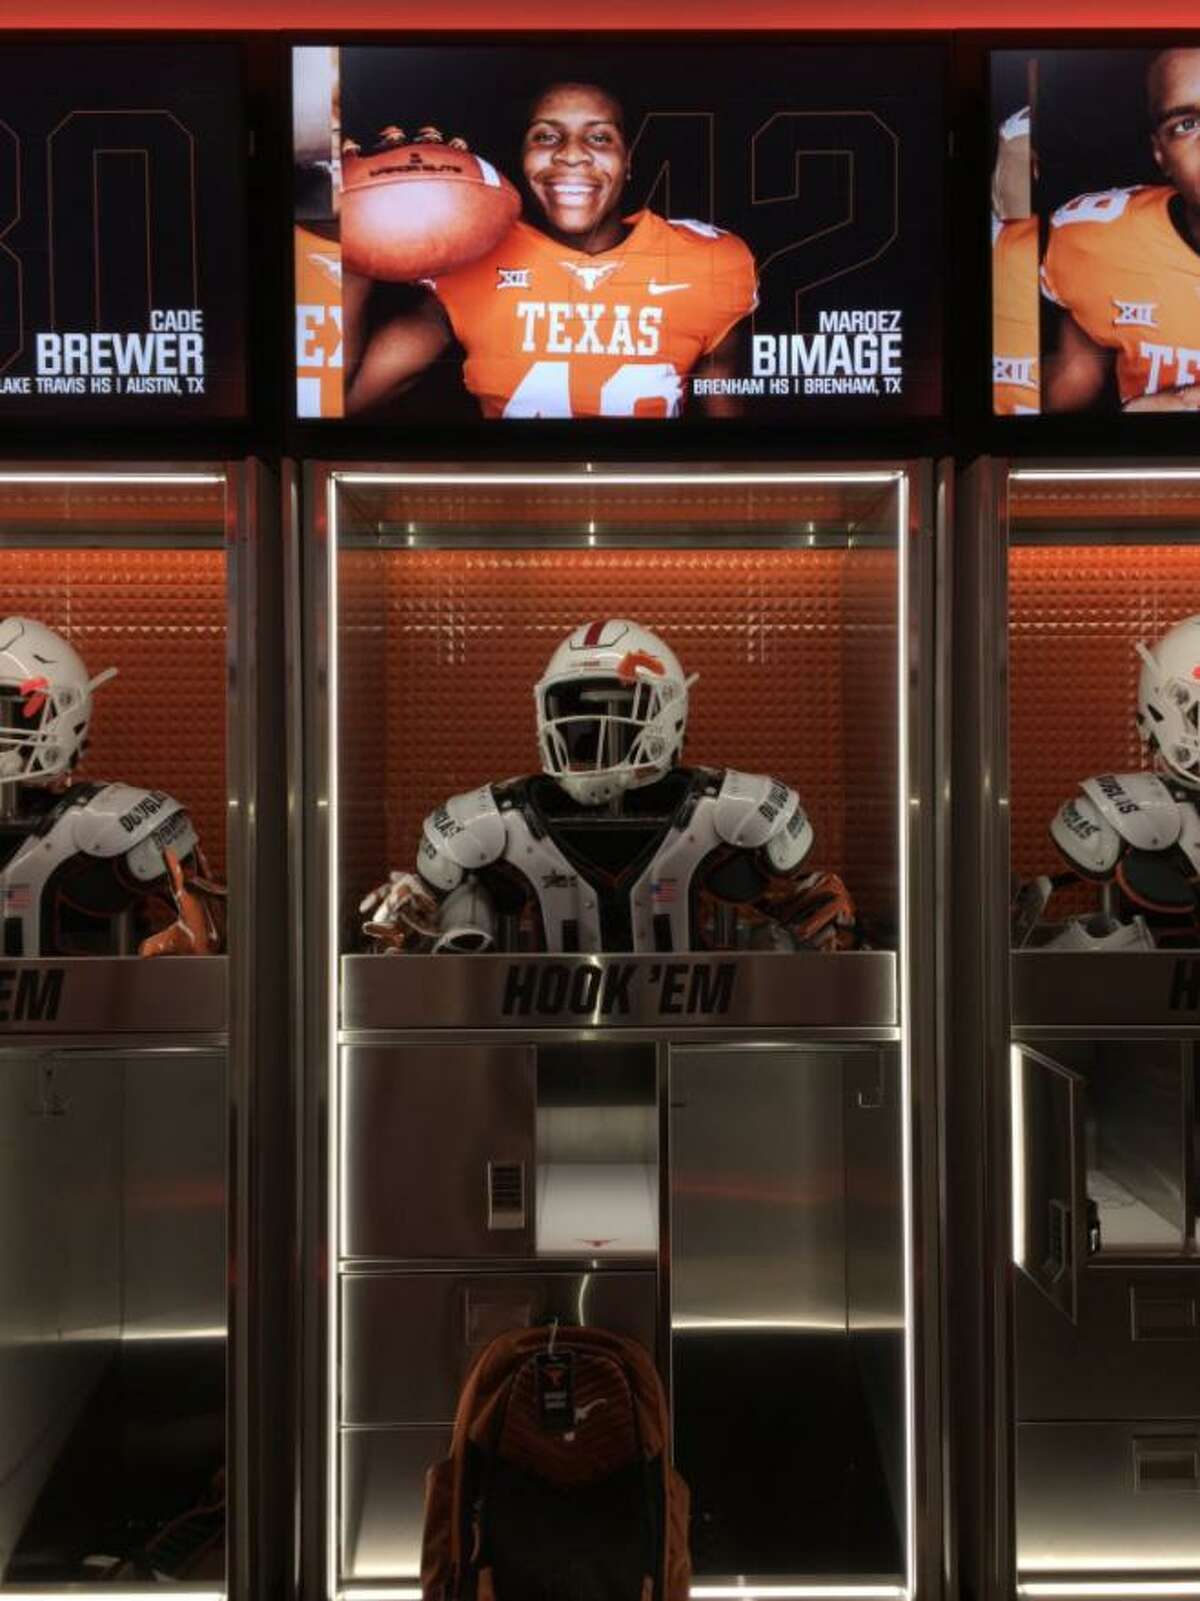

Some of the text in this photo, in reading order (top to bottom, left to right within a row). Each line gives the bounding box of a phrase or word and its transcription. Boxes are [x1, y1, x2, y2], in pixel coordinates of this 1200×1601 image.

[151, 310, 204, 332] CADE
[516, 302, 663, 357] TEXAS
[818, 310, 902, 337] MARQEZ
[36, 333, 204, 376] BREWER
[752, 334, 903, 376] BIMAGE
[36, 377, 86, 394] TRAVIS
[91, 377, 111, 394] HS
[126, 377, 182, 398] AUSTIN,
[187, 377, 205, 394] TX
[693, 378, 764, 395] BRENHAM
[769, 378, 789, 395] HS
[804, 378, 880, 397] BRENHAM,
[884, 378, 902, 394] TX
[502, 962, 737, 1016] HOOK 'EM
